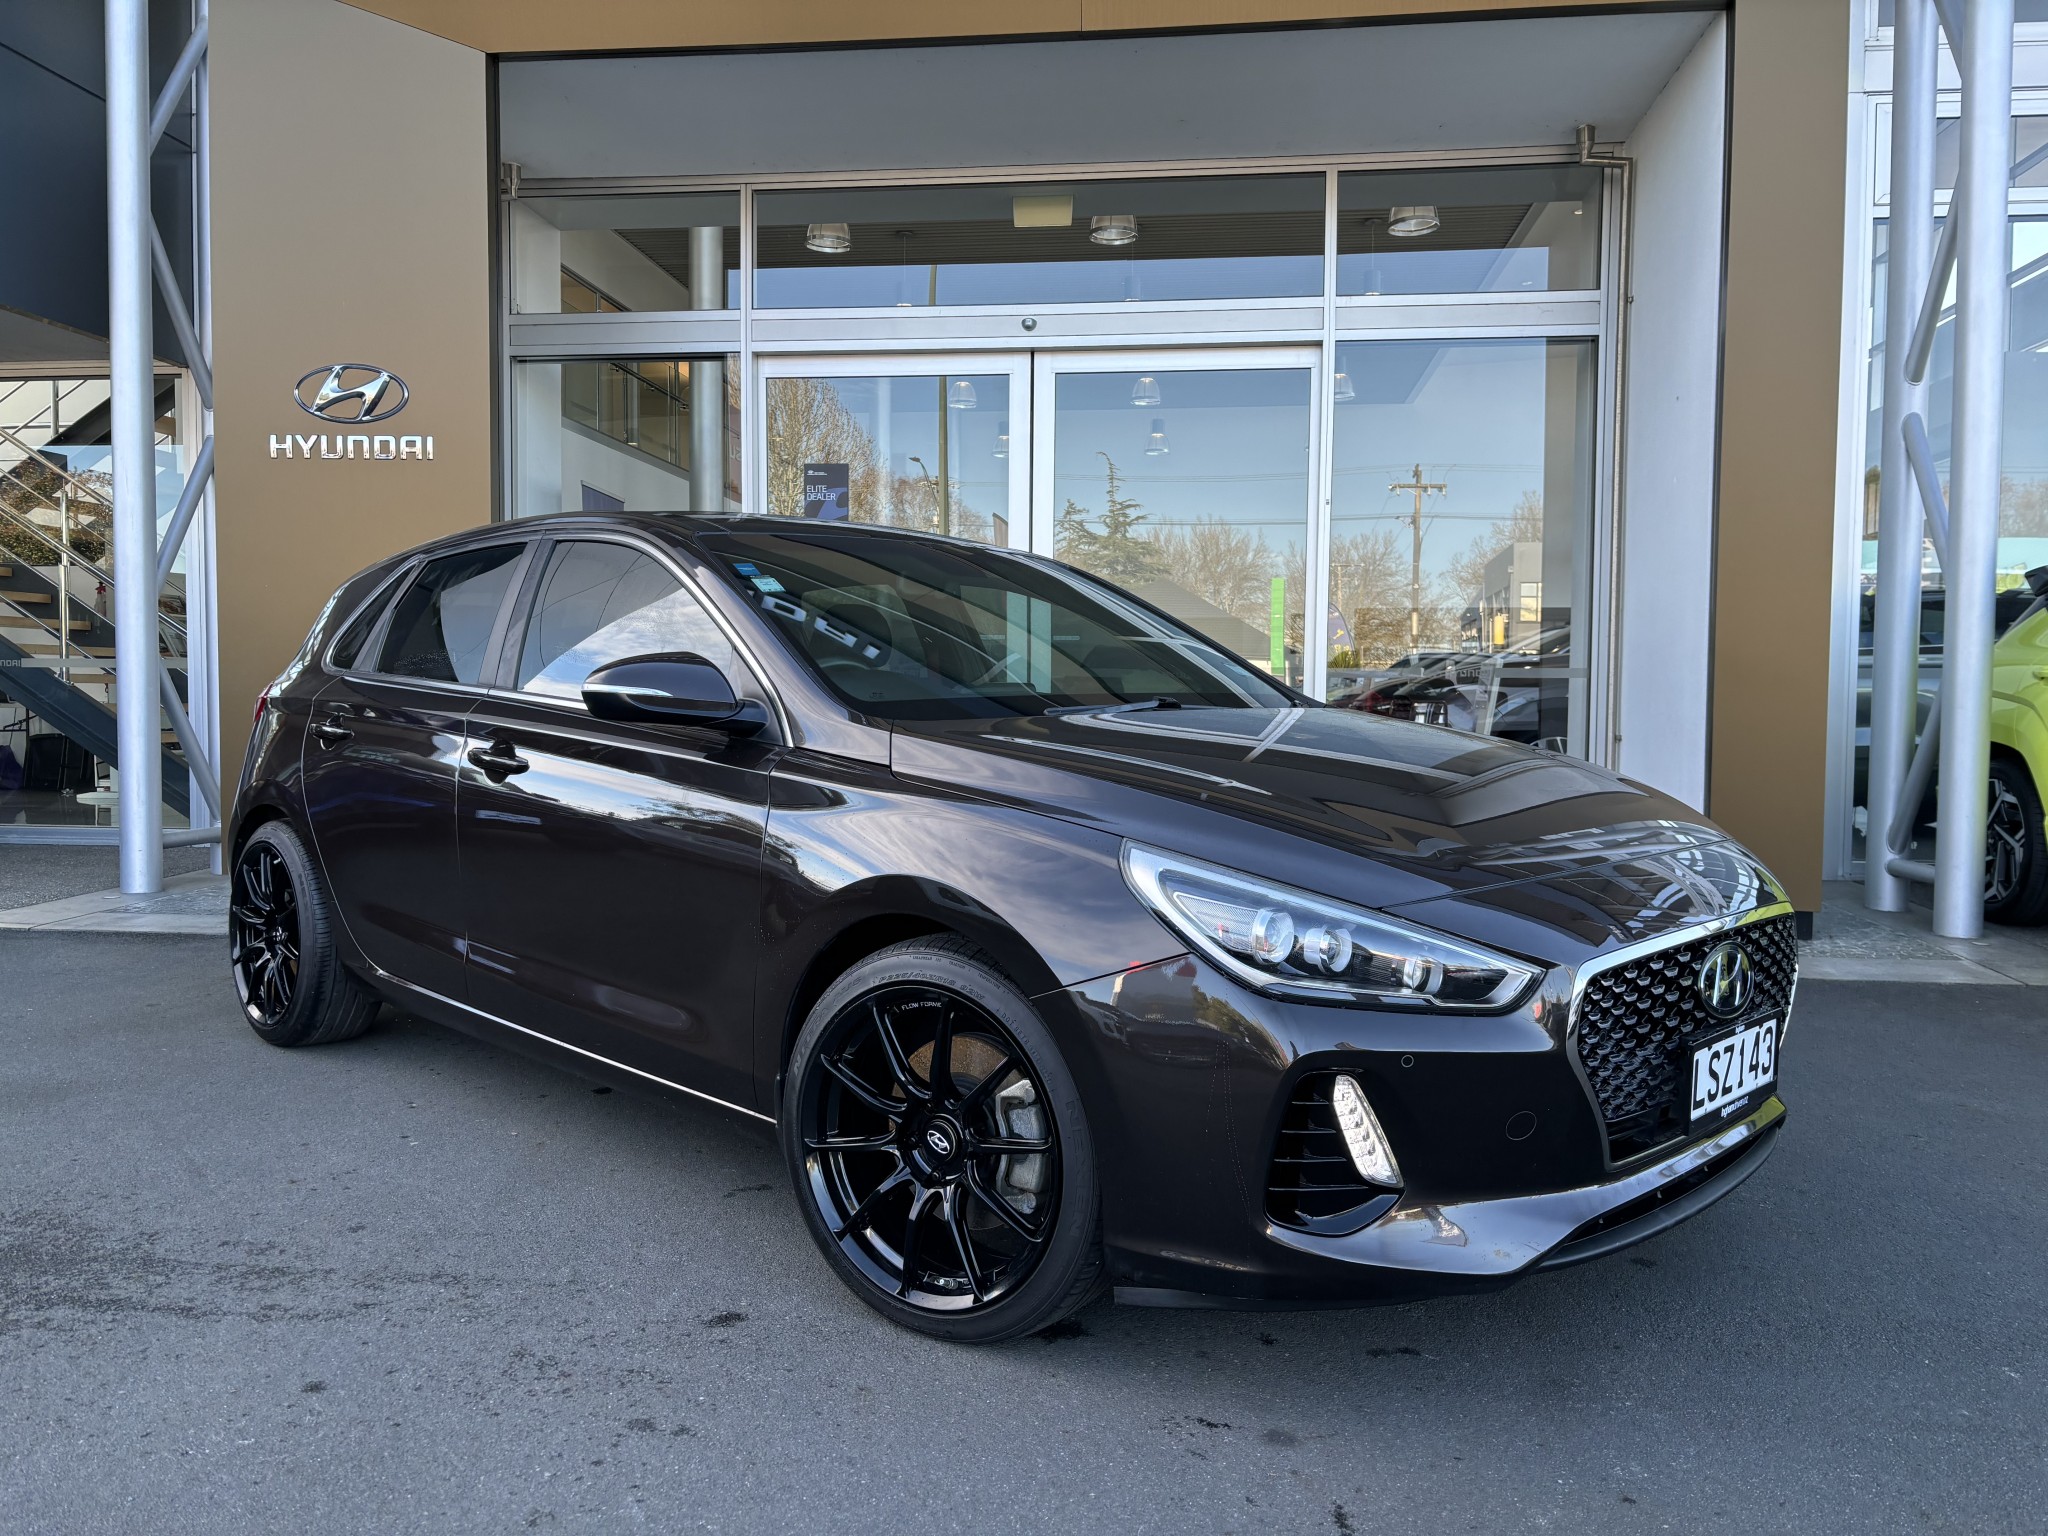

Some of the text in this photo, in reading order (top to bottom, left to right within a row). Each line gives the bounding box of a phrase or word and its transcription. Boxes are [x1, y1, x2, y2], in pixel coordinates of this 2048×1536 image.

[269, 434, 434, 460] HYUNDAI
[806, 485, 828, 493] ELITE
[806, 493, 836, 501] DEALER
[901, 1001, 919, 1011] FLOW
[1692, 1026, 1773, 1111] LSZ143
